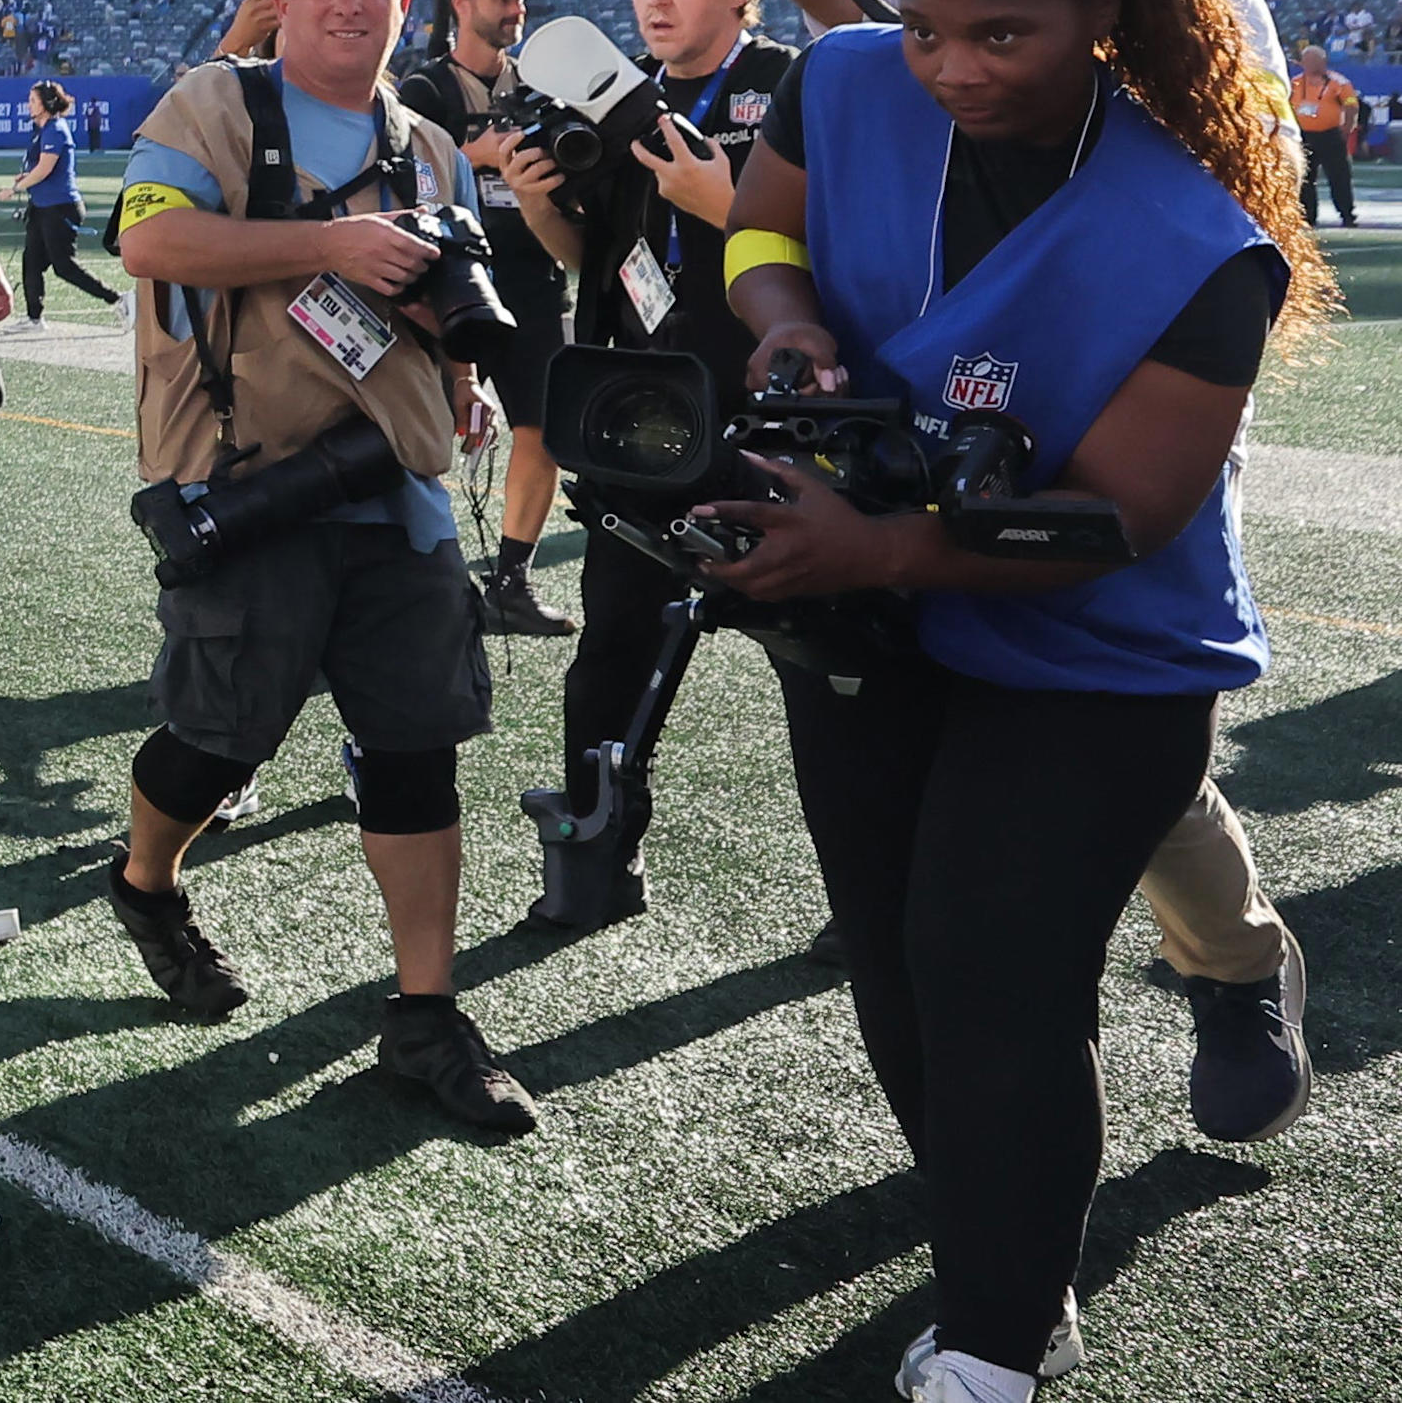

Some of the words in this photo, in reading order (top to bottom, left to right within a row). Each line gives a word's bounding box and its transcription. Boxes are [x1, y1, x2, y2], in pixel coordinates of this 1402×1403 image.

[736, 105, 763, 119] NFL
[951, 374, 1001, 405] NFL
[913, 412, 950, 441] NFL
